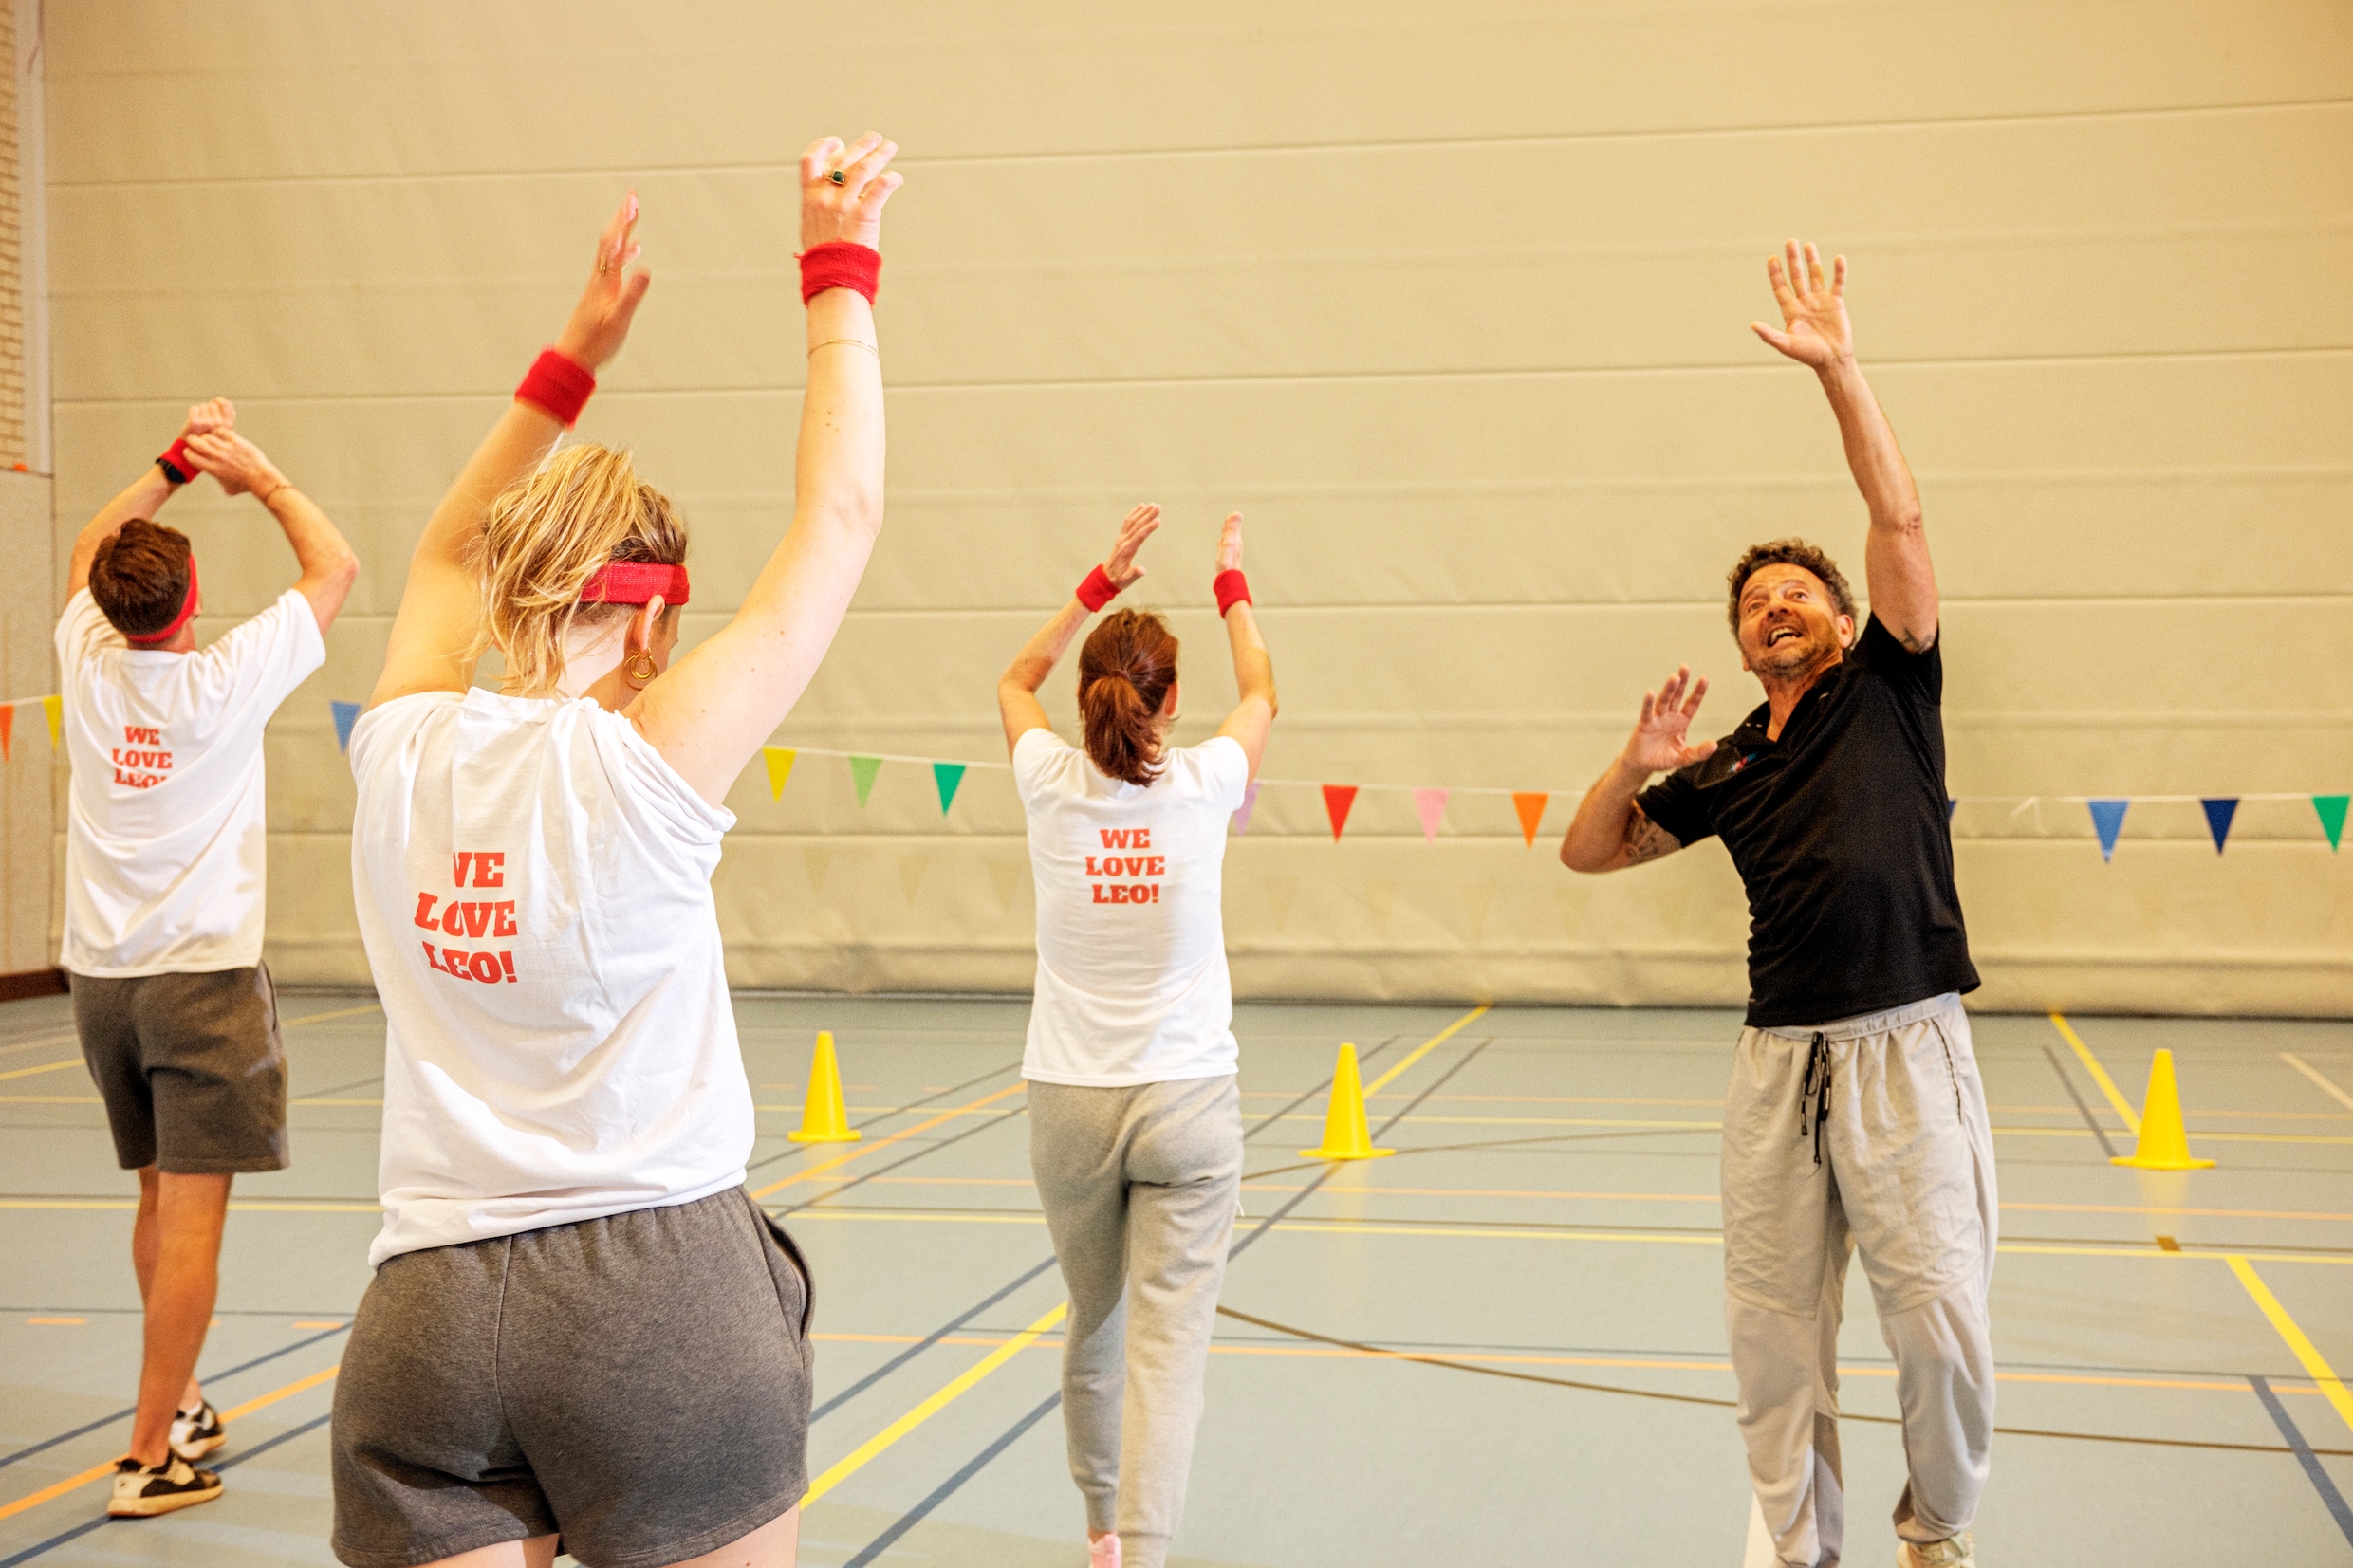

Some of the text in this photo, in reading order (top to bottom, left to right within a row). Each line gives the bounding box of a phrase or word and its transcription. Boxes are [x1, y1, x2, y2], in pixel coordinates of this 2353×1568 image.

[124, 726, 160, 746] WE
[112, 748, 173, 769] LOVE
[114, 767, 167, 789] LEO
[1100, 828, 1151, 849] WE
[1085, 855, 1166, 876] LOVE
[1092, 883, 1160, 904] LEO!
[414, 891, 518, 938] LOVE
[422, 940, 518, 985] LEO!
